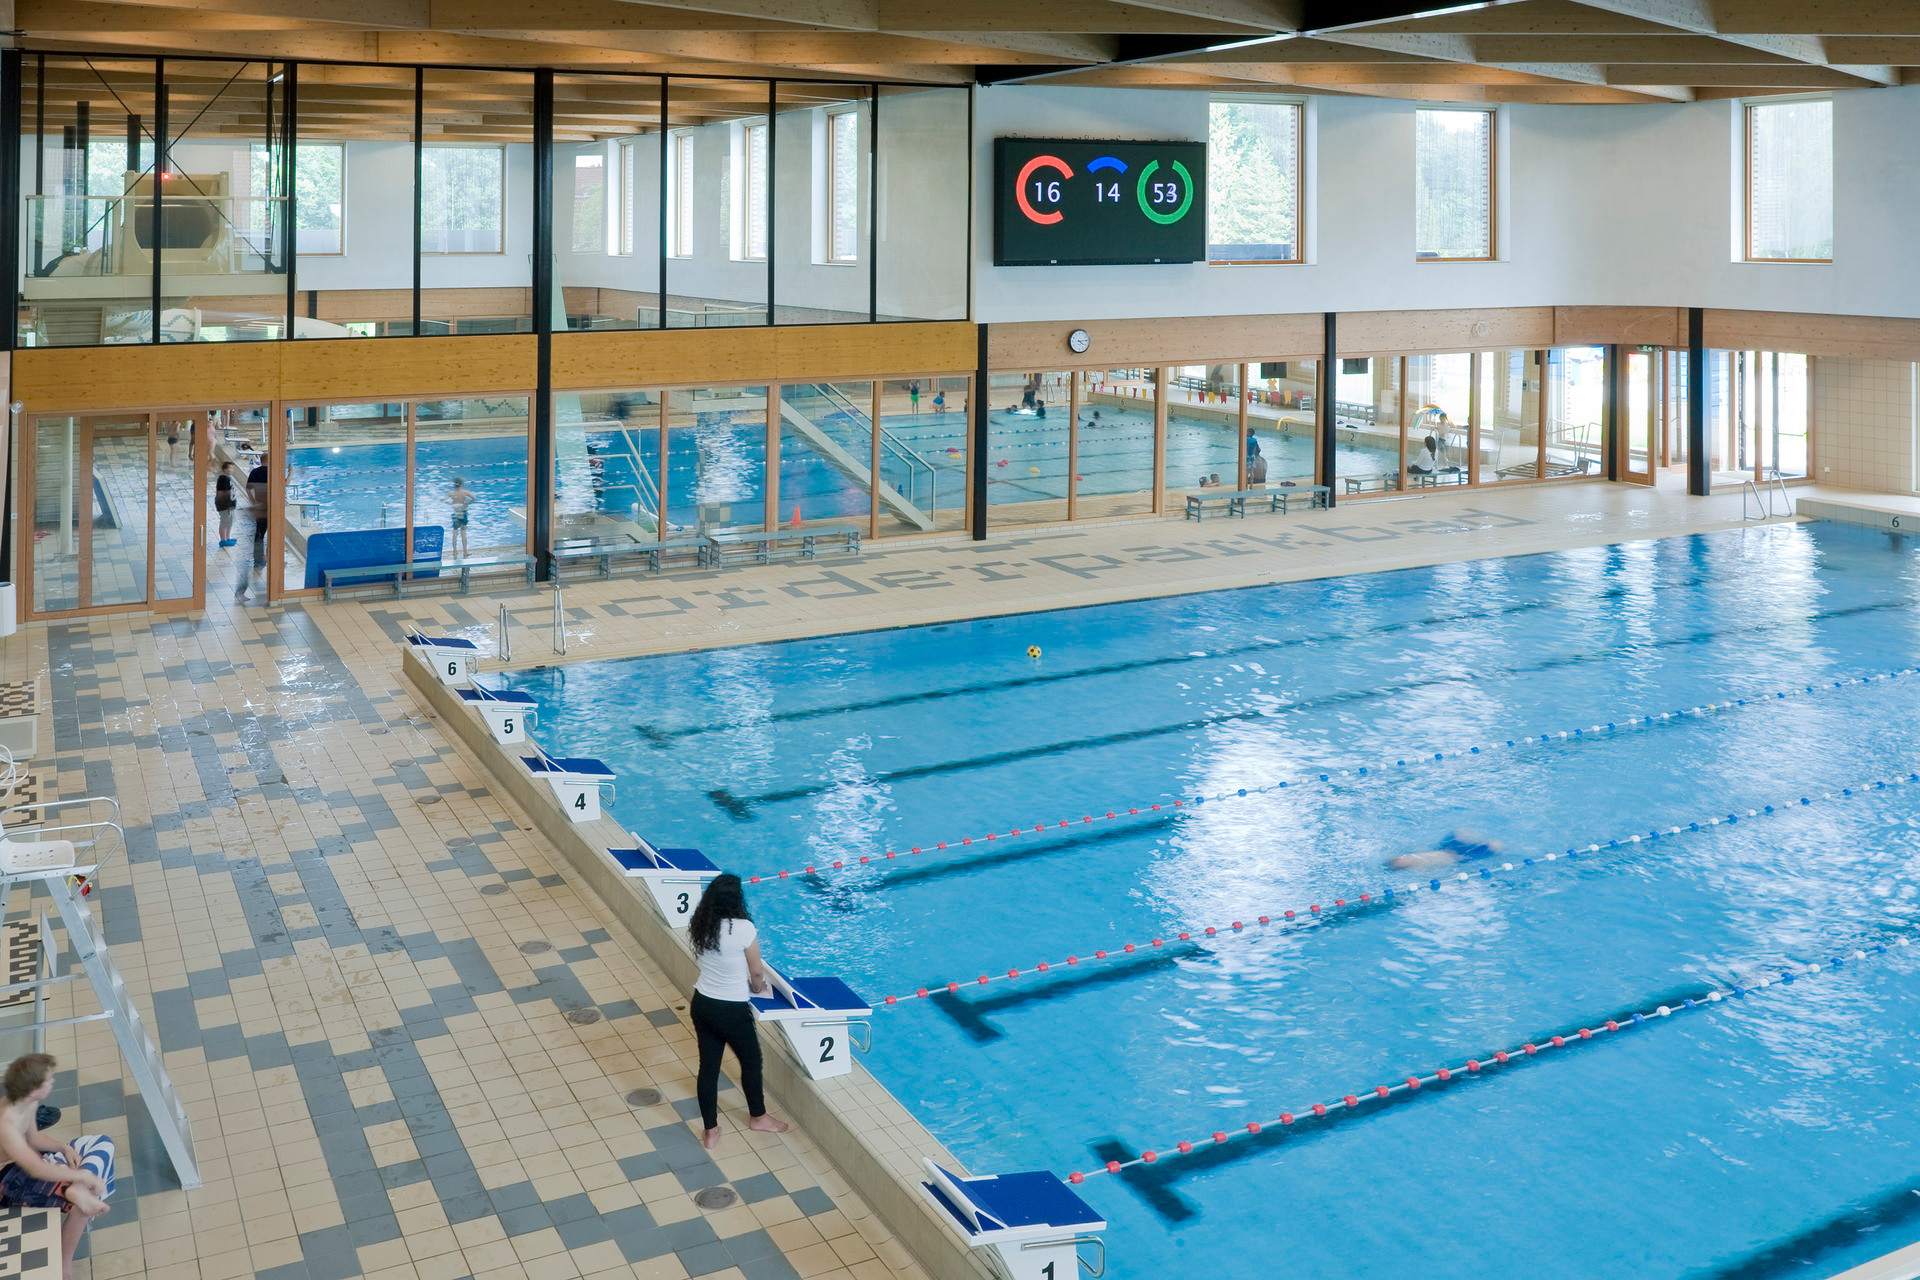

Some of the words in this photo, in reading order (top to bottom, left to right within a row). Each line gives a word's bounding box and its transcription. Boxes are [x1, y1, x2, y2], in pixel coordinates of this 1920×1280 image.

[1035, 181, 1061, 203] 16
[1095, 182, 1121, 203] 14
[1891, 516, 1900, 527] 6
[447, 661, 457, 676] 6
[504, 718, 514, 735] 5
[574, 792, 587, 811] 4
[676, 892, 690, 914] 3
[819, 1036, 835, 1064] 2
[1041, 1260, 1055, 1280] 1
